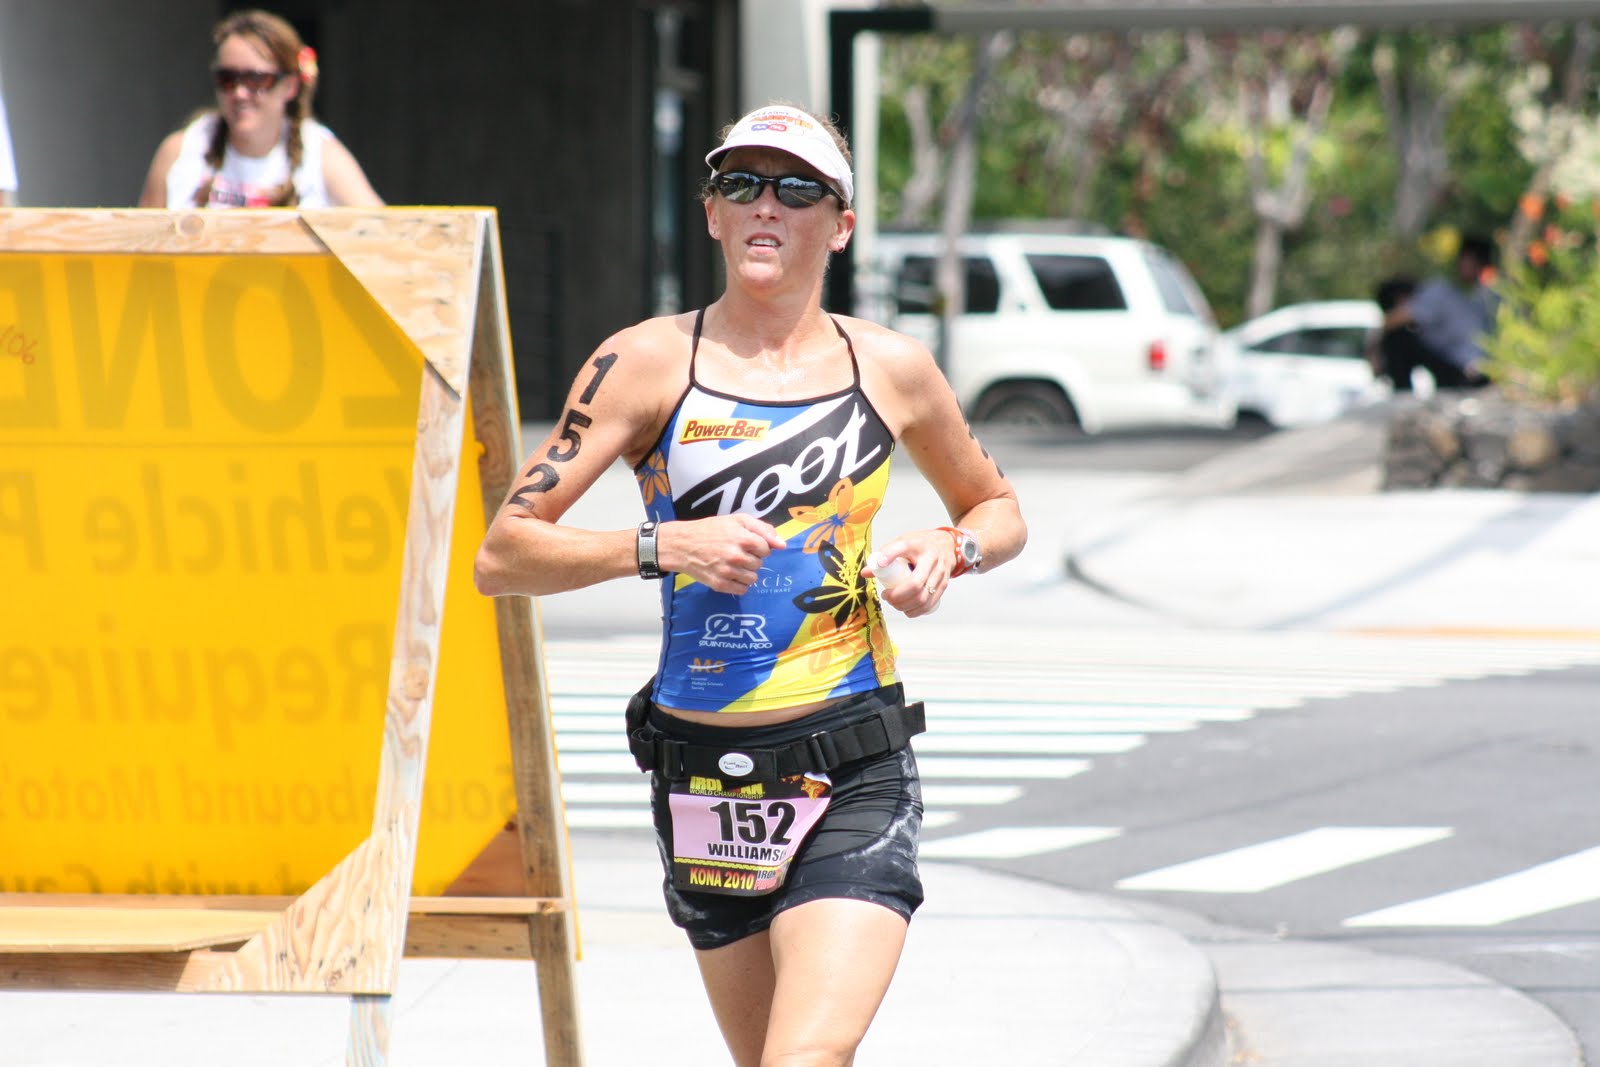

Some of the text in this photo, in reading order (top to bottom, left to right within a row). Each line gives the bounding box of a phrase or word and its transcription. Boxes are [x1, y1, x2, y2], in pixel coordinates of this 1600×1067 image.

[683, 420, 765, 438] PowerBar
[690, 788, 764, 800] WORLD CHAMPIONSHIP
[709, 801, 796, 845] 152
[690, 867, 721, 886] KONA
[725, 872, 755, 890] 2010
